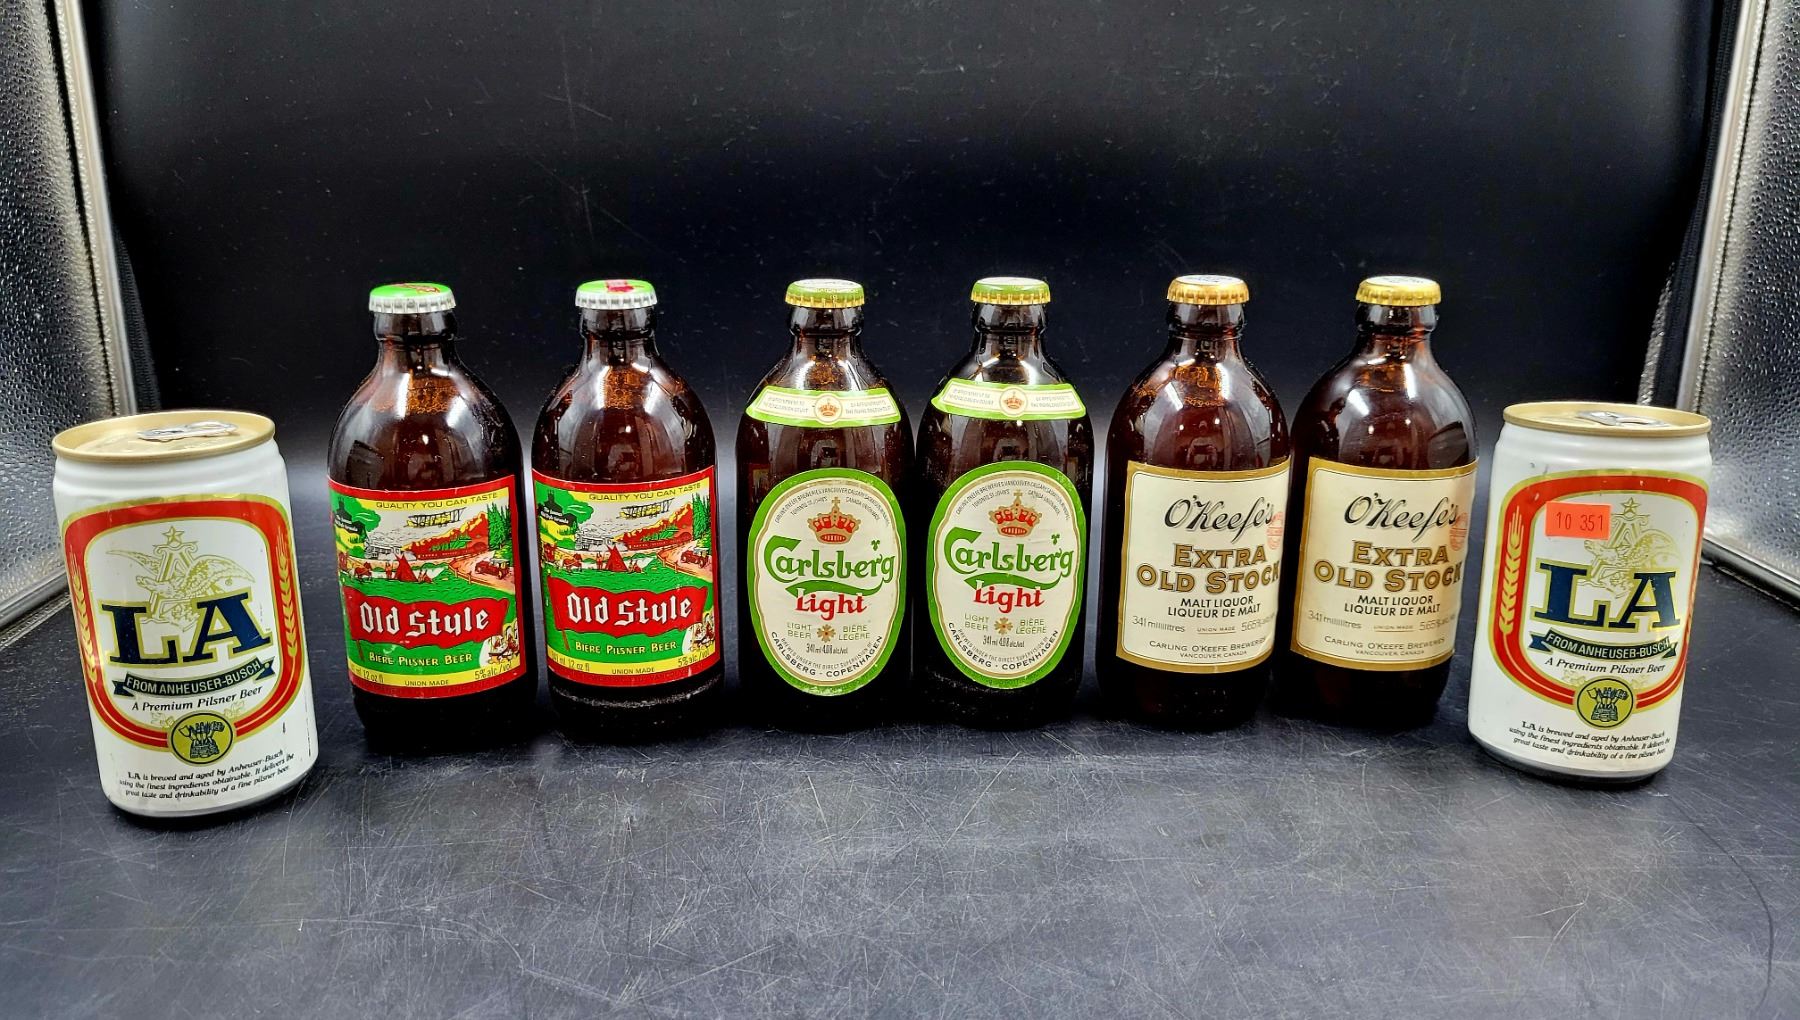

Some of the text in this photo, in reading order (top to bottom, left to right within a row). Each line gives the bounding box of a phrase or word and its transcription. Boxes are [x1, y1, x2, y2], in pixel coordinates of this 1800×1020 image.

[376, 492, 498, 510] QUALITY YOU CAN TASTE
[589, 483, 701, 501] QUALITY YOU CAN TASTE
[1164, 495, 1274, 544] O'Keefe's
[1344, 492, 1459, 543] O'Keefe's
[1555, 511, 1604, 532] 10 351
[764, 535, 896, 585] Carlsberg
[944, 527, 1074, 578] Carlsberg
[1173, 543, 1267, 569] EXTRA
[1351, 540, 1449, 567] EXTRA
[1136, 560, 1280, 594] OLD STOCK
[1314, 560, 1463, 593] OLD STOCK
[795, 588, 867, 621] Light
[973, 580, 1045, 613] Light
[1180, 595, 1254, 608] MALT LIQUOR
[1358, 595, 1433, 606] MALT LIQUOR
[1534, 561, 1680, 629] LA
[360, 602, 489, 637] Old Style
[567, 592, 692, 626] Old Style
[965, 613, 990, 623] LIGHT
[1168, 606, 1218, 619] LIQUEUR
[1238, 603, 1260, 617] MALT
[1308, 610, 1362, 629] 341 millilitres
[1344, 603, 1440, 616] LIQUEUR DE MALT
[101, 591, 271, 664] LA
[787, 622, 812, 631] LIGHT
[787, 630, 811, 639] BEER
[965, 621, 988, 631] BEER
[1132, 616, 1186, 632] 341 millilitres
[607, 645, 645, 655] PILSNER
[651, 641, 677, 651] BEER
[949, 622, 1058, 670] CARLSBERG COPENHAGEN
[1150, 640, 1188, 651] CARLING
[1324, 635, 1363, 648] CARLING
[1546, 633, 1669, 659] FROM ANHEUSER-BUSCH
[399, 656, 439, 666] PILSNER
[444, 652, 472, 665] BEER
[771, 632, 882, 678] CARLSBERG COPENHAGEN
[1224, 650, 1247, 658] CANADA
[1544, 657, 1665, 673] A Premium Pilsner Beer
[126, 662, 261, 694] FROM ANHEUSER-BUSCH
[132, 685, 263, 711] A Premium Pilsner Beer
[1509, 727, 1526, 737] using
[1527, 731, 1538, 739] the
[1540, 735, 1560, 744] finest
[1562, 739, 1604, 750] ingredients
[1522, 721, 1535, 730] LA
[1546, 727, 1573, 738] brewed
[1591, 734, 1609, 742] aged
[1611, 735, 1620, 743] by
[1513, 736, 1531, 746] great
[1532, 741, 1549, 750] taste
[1567, 749, 1609, 760] drinkability
[1625, 751, 1637, 759] fine
[128, 772, 141, 780] LA
[151, 773, 176, 781] brewed
[179, 771, 193, 780] and
[196, 769, 214, 780] aged
[217, 767, 226, 776] by
[228, 749, 283, 773] Anheuser-Busch
[168, 779, 209, 791] ingredients
[175, 787, 218, 799] drinkability
